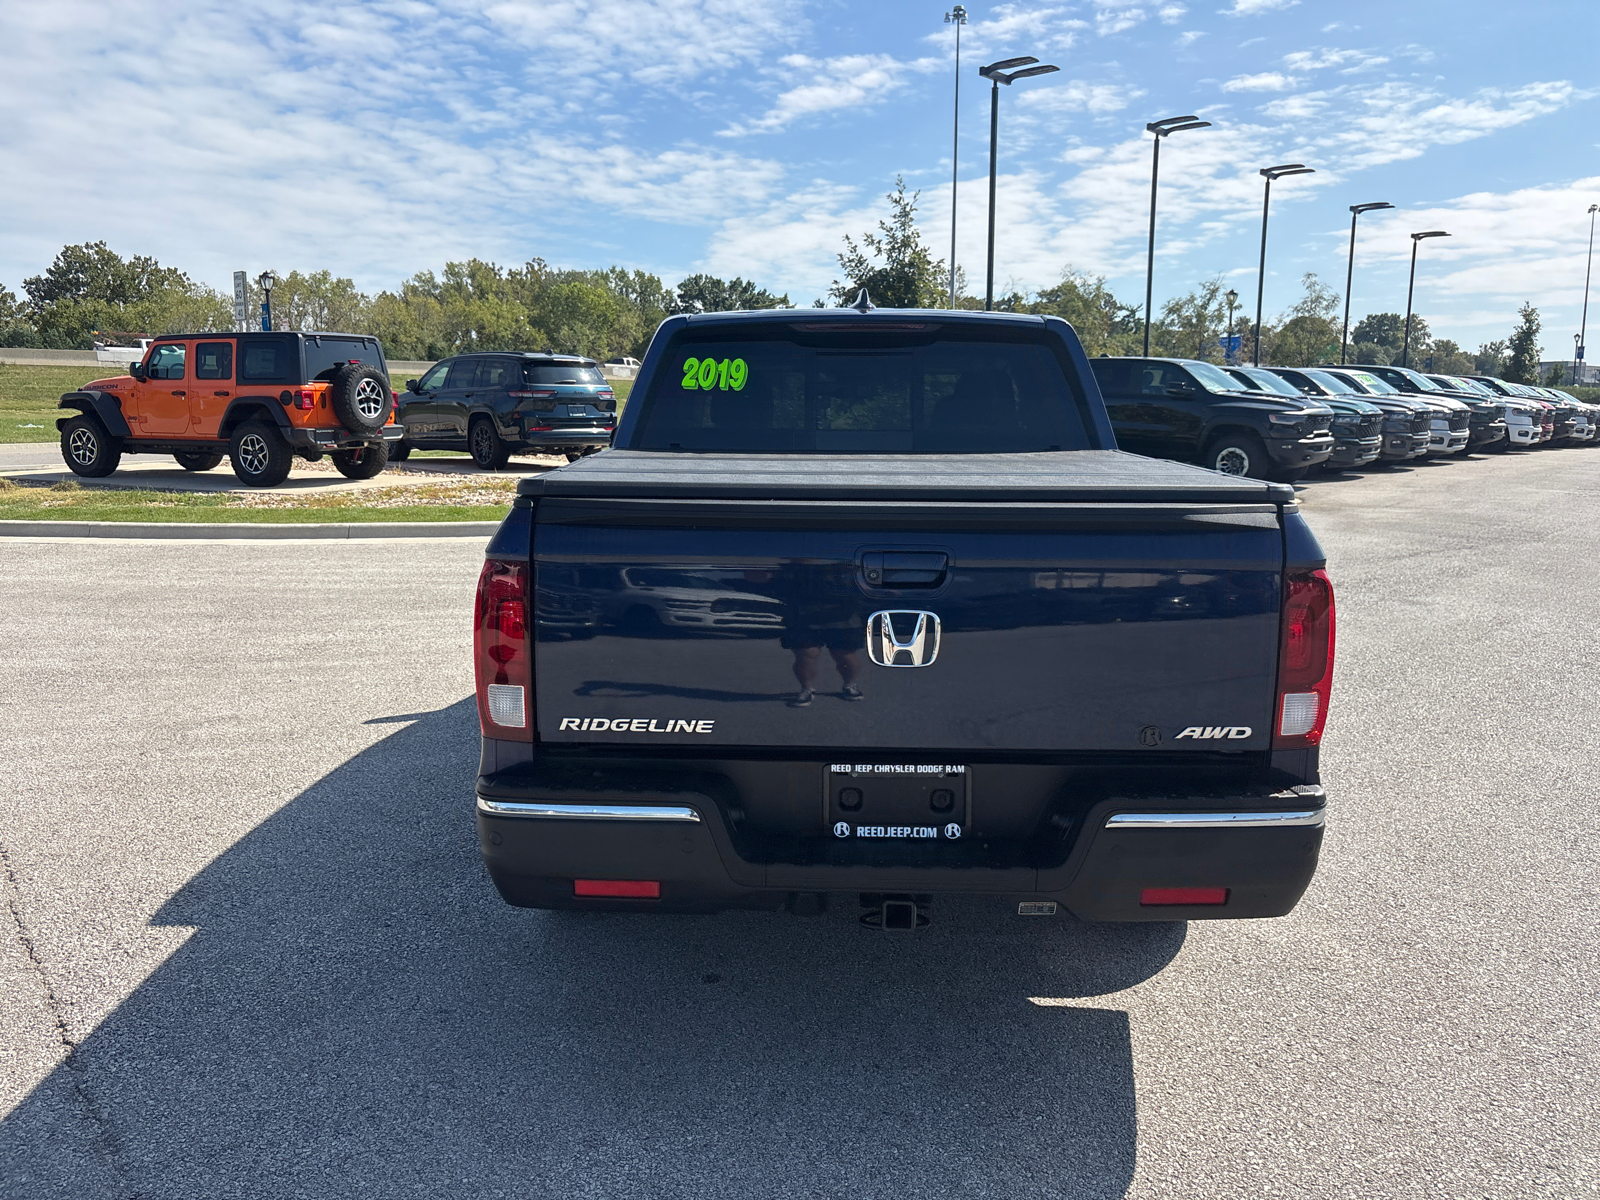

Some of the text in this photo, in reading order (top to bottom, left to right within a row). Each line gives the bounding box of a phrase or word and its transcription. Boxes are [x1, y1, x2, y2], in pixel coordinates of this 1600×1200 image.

[236, 290, 243, 300] 60
[681, 357, 749, 392] 2019
[559, 717, 716, 733] RIDGELINE
[1174, 726, 1253, 740] AWD
[831, 764, 965, 773] REED JEEP CHRYSLER DODGE RAM
[856, 826, 938, 838] REEDJEEP.COM
